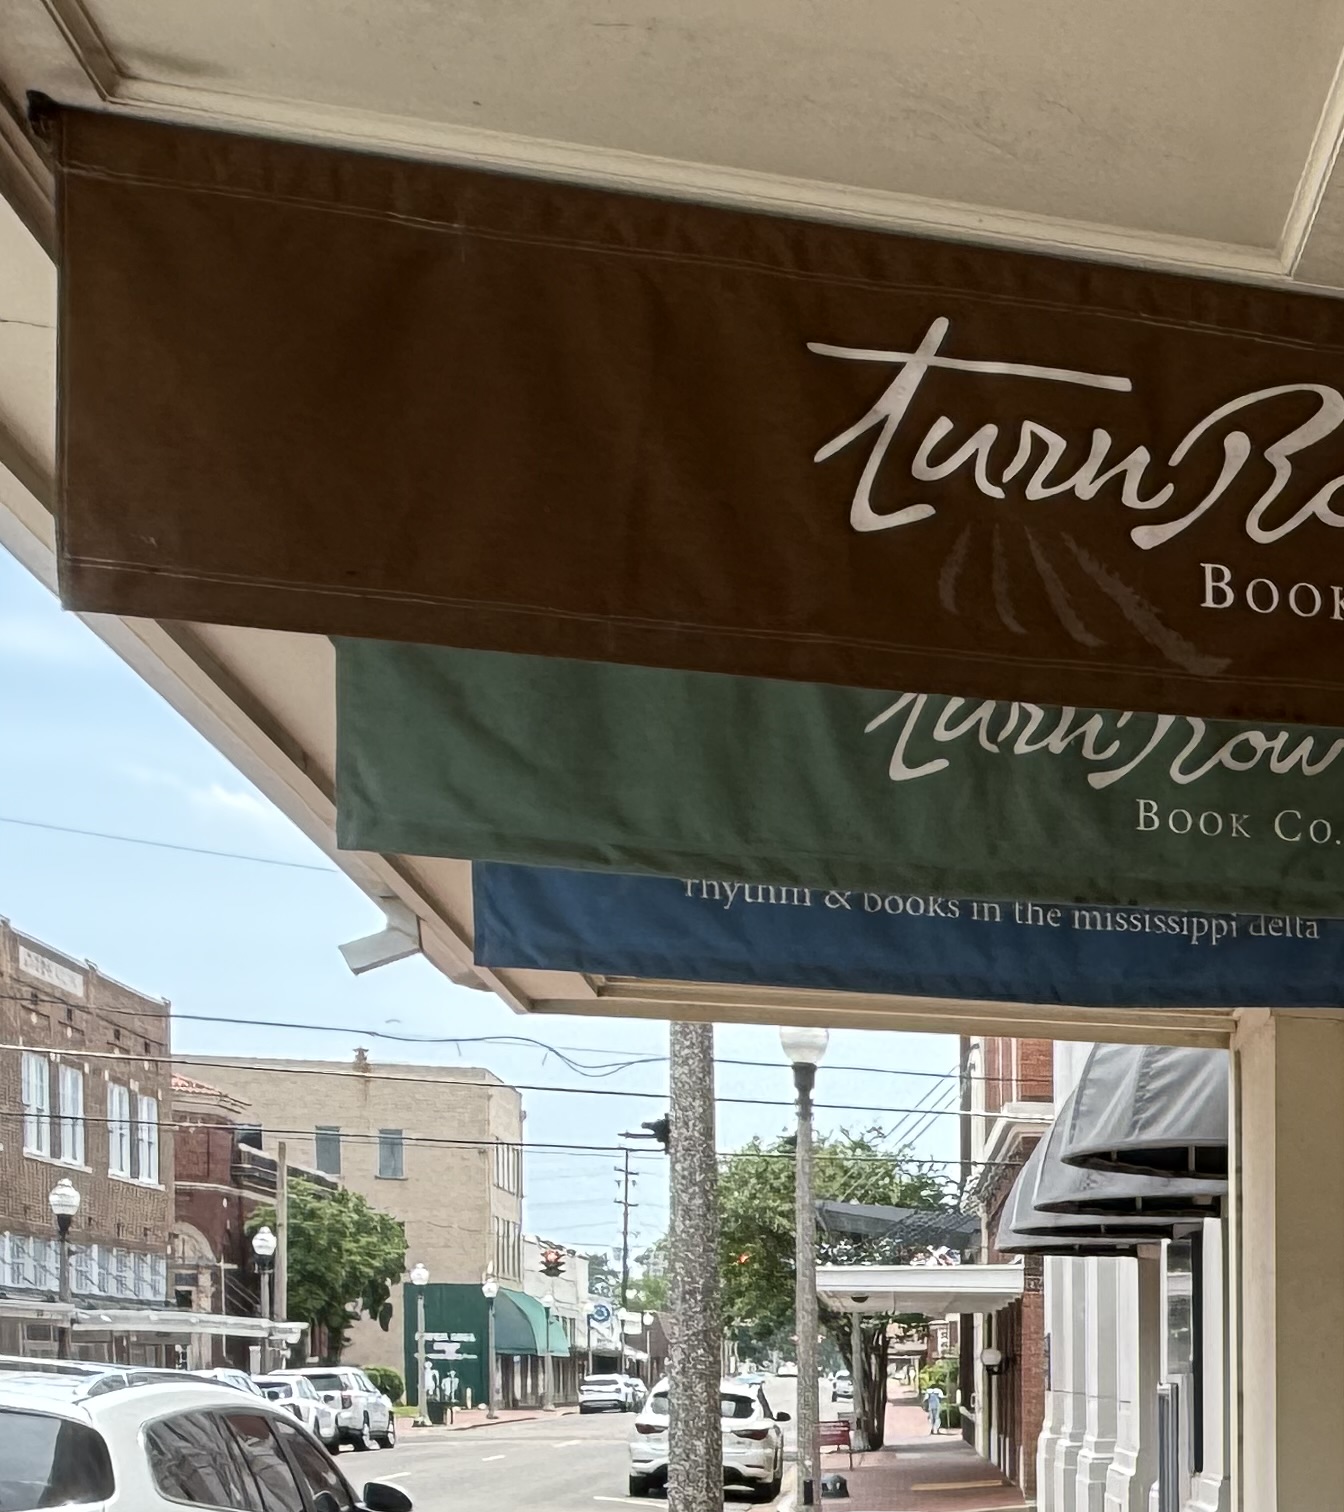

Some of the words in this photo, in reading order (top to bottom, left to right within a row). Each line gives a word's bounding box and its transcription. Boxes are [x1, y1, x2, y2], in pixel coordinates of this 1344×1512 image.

[823, 890, 852, 909] &
[971, 901, 1001, 922] in
[1013, 902, 1062, 928] the
[1070, 909, 1239, 945] mississippi
[1248, 915, 1320, 940] delta
